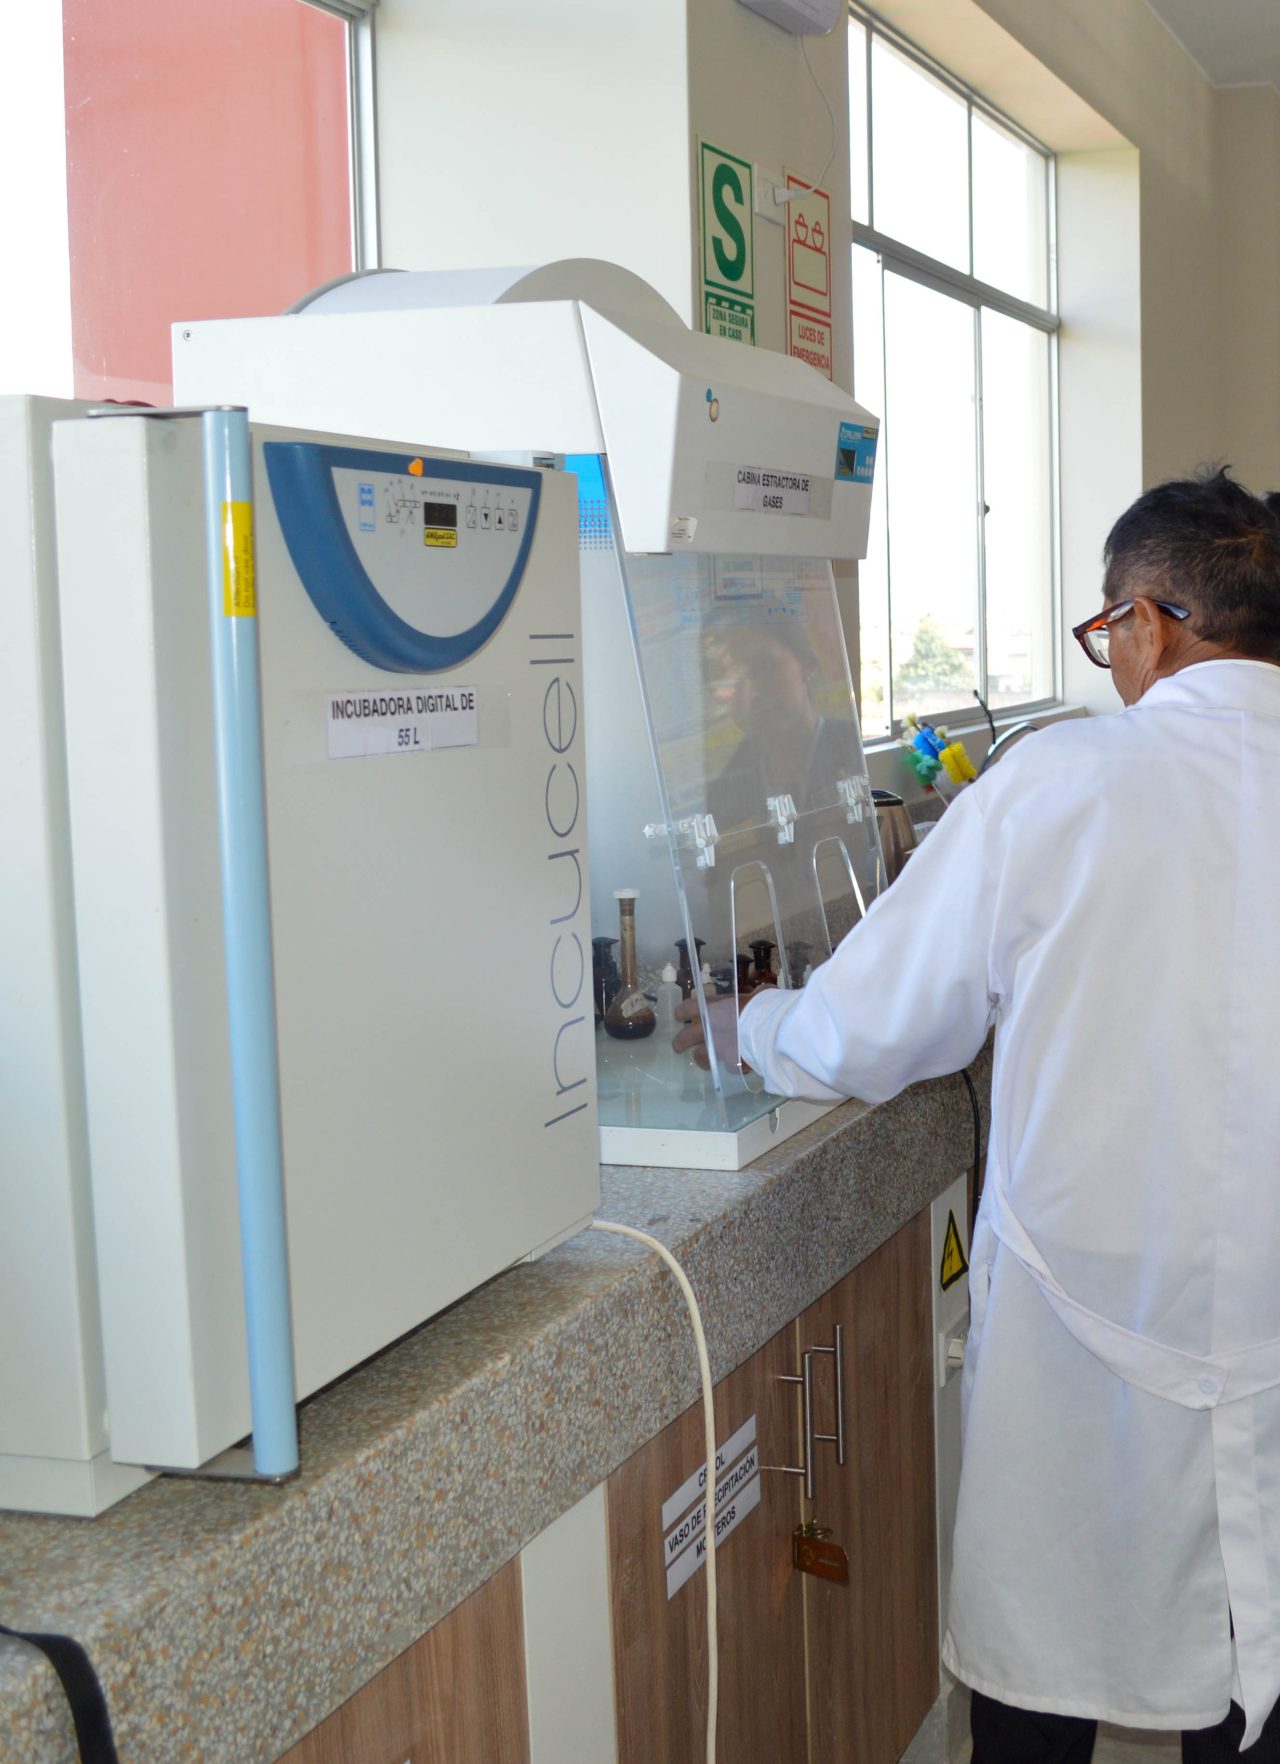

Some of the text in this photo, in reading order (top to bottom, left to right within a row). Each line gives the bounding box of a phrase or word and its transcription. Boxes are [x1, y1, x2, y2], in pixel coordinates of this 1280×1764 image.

[712, 163, 745, 281] S
[712, 308, 749, 328] ZONA SEGURA
[720, 325, 742, 340] EN CASO
[798, 324, 825, 346] LUCES DE
[793, 346, 829, 368] EMERGENCIA
[737, 470, 810, 491] CABINA ESTRACTORA DE
[763, 495, 784, 509] GASES
[332, 693, 475, 720] INCUBADORA DIGITAL DE
[398, 727, 420, 746] 55 L
[668, 1454, 755, 1553] VASO DE PECIPITACIÓN
[696, 1505, 736, 1559] MOTEROS
